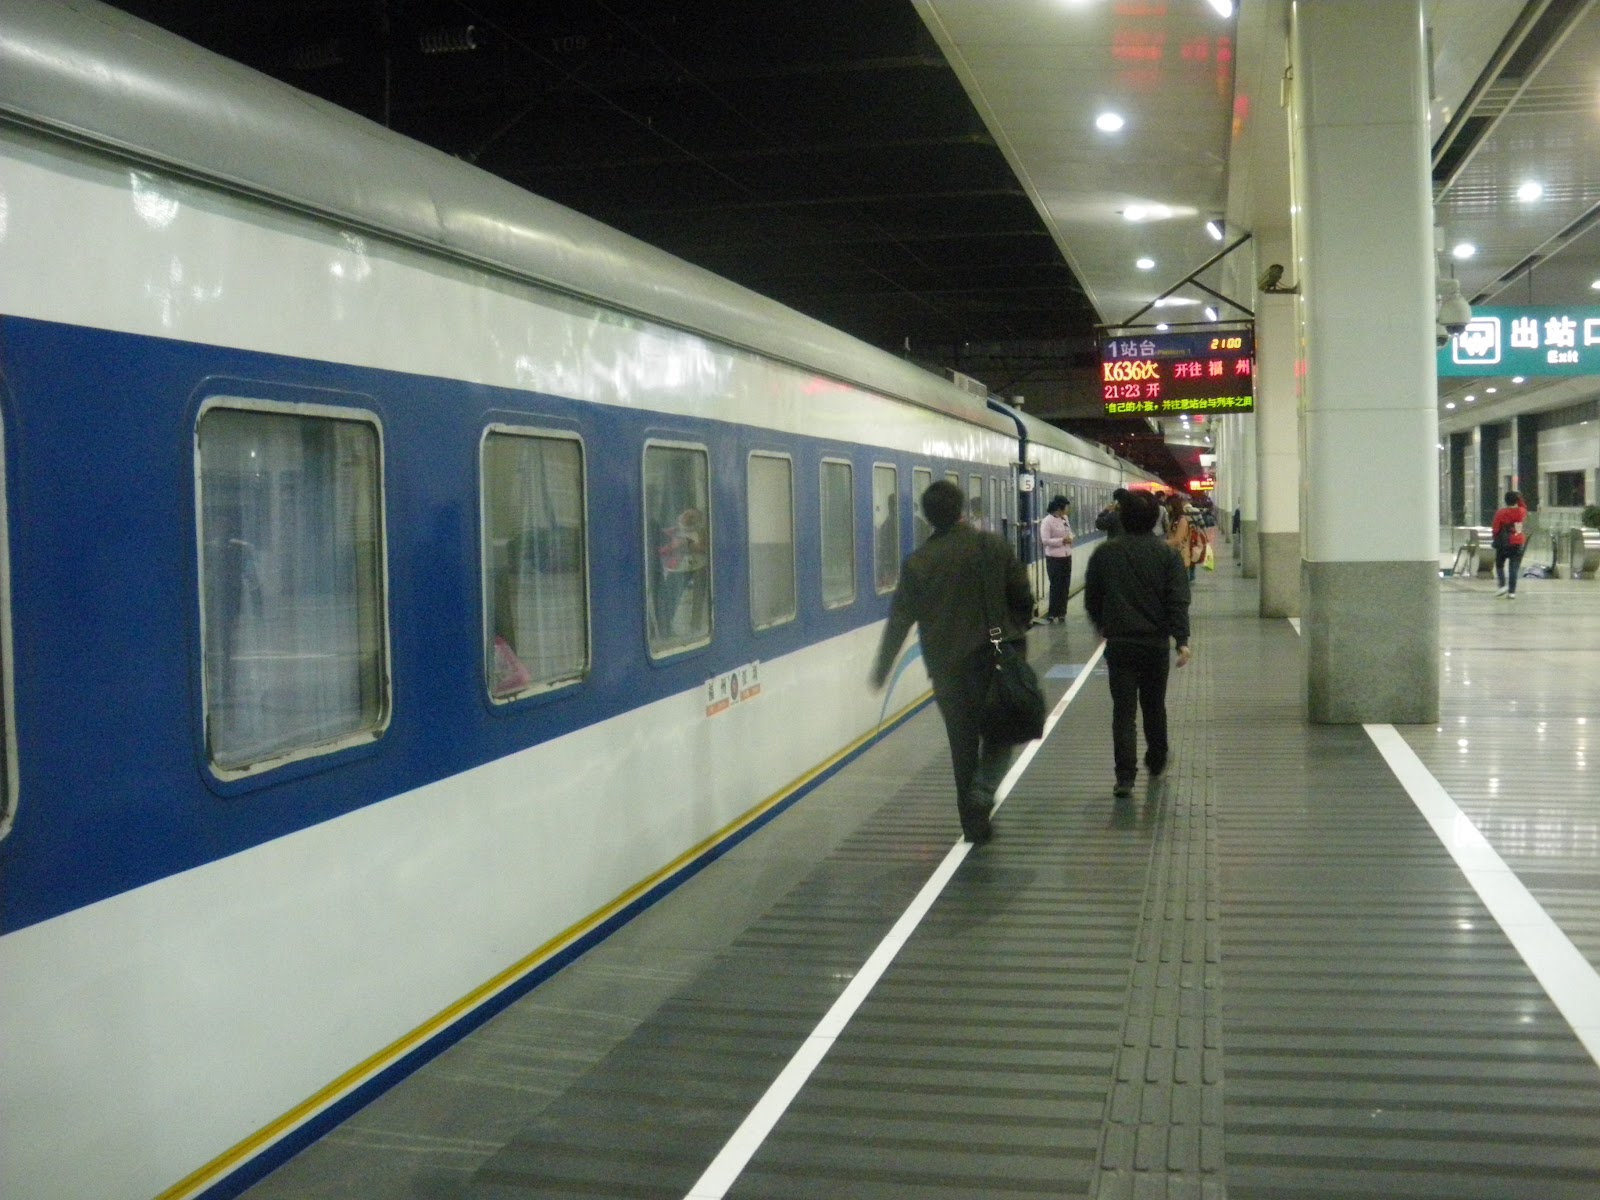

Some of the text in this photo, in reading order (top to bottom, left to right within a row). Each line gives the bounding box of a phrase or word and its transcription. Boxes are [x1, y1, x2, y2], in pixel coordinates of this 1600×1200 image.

[1108, 340, 1156, 357] 1站台
[1547, 350, 1579, 363] Exit
[1104, 360, 1160, 381] K636次
[1174, 362, 1202, 378] 开往
[1104, 383, 1160, 399] 21:23 开
